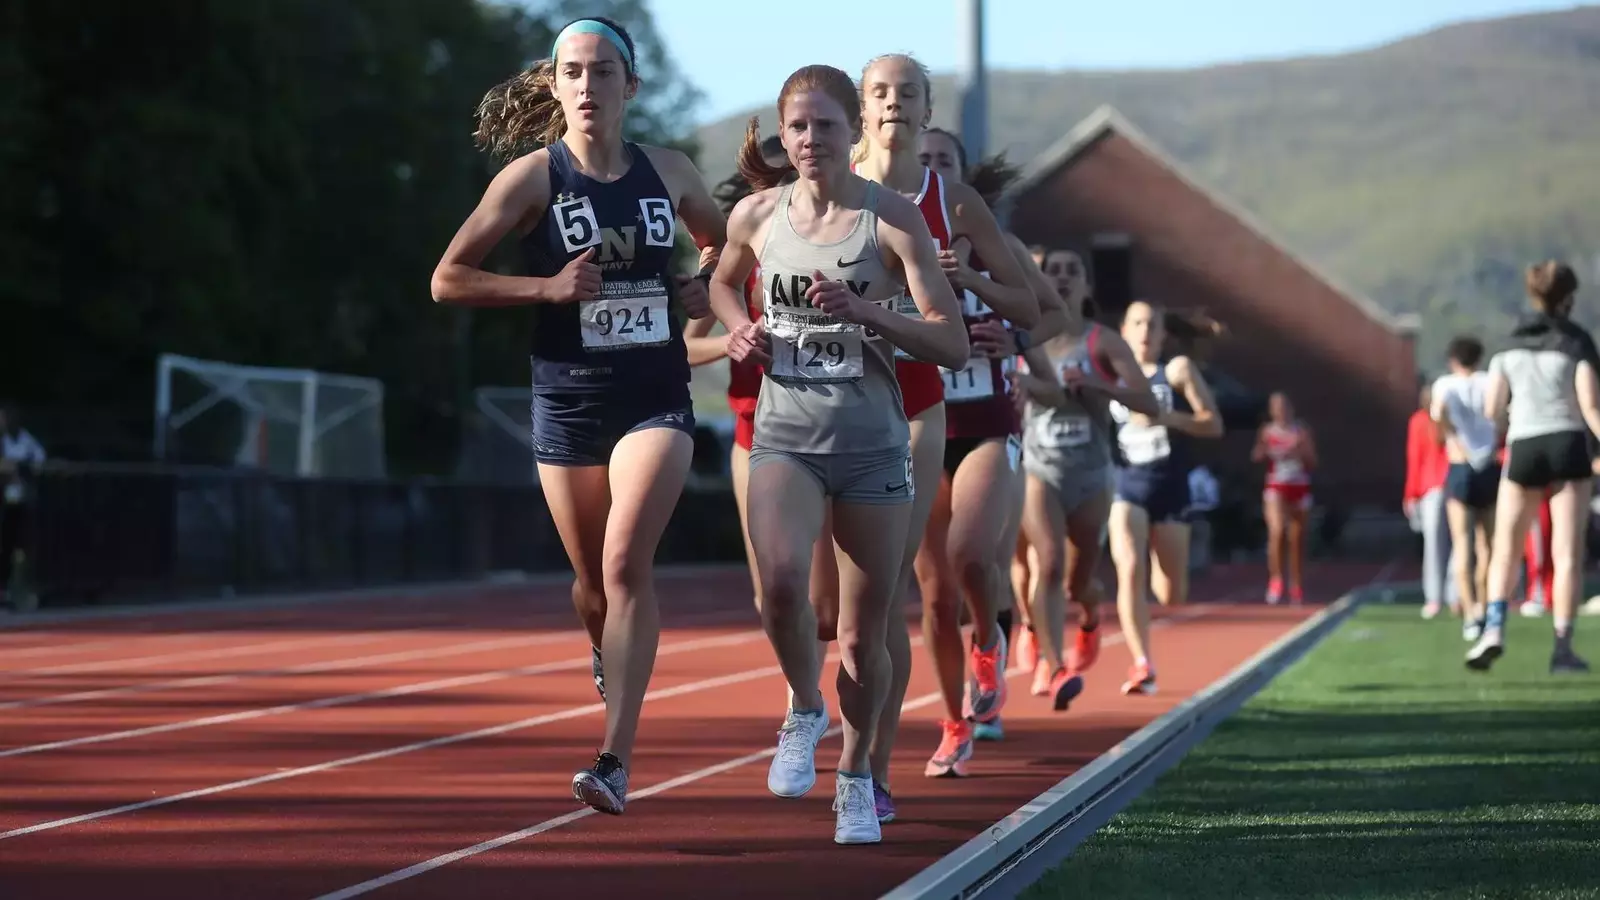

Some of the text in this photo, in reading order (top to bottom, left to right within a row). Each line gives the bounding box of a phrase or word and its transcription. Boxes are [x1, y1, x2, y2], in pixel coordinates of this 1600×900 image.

[560, 202, 593, 246] 5
[645, 201, 671, 243] 5
[599, 226, 637, 262] N
[595, 306, 653, 336] 924
[786, 341, 844, 367] 129
